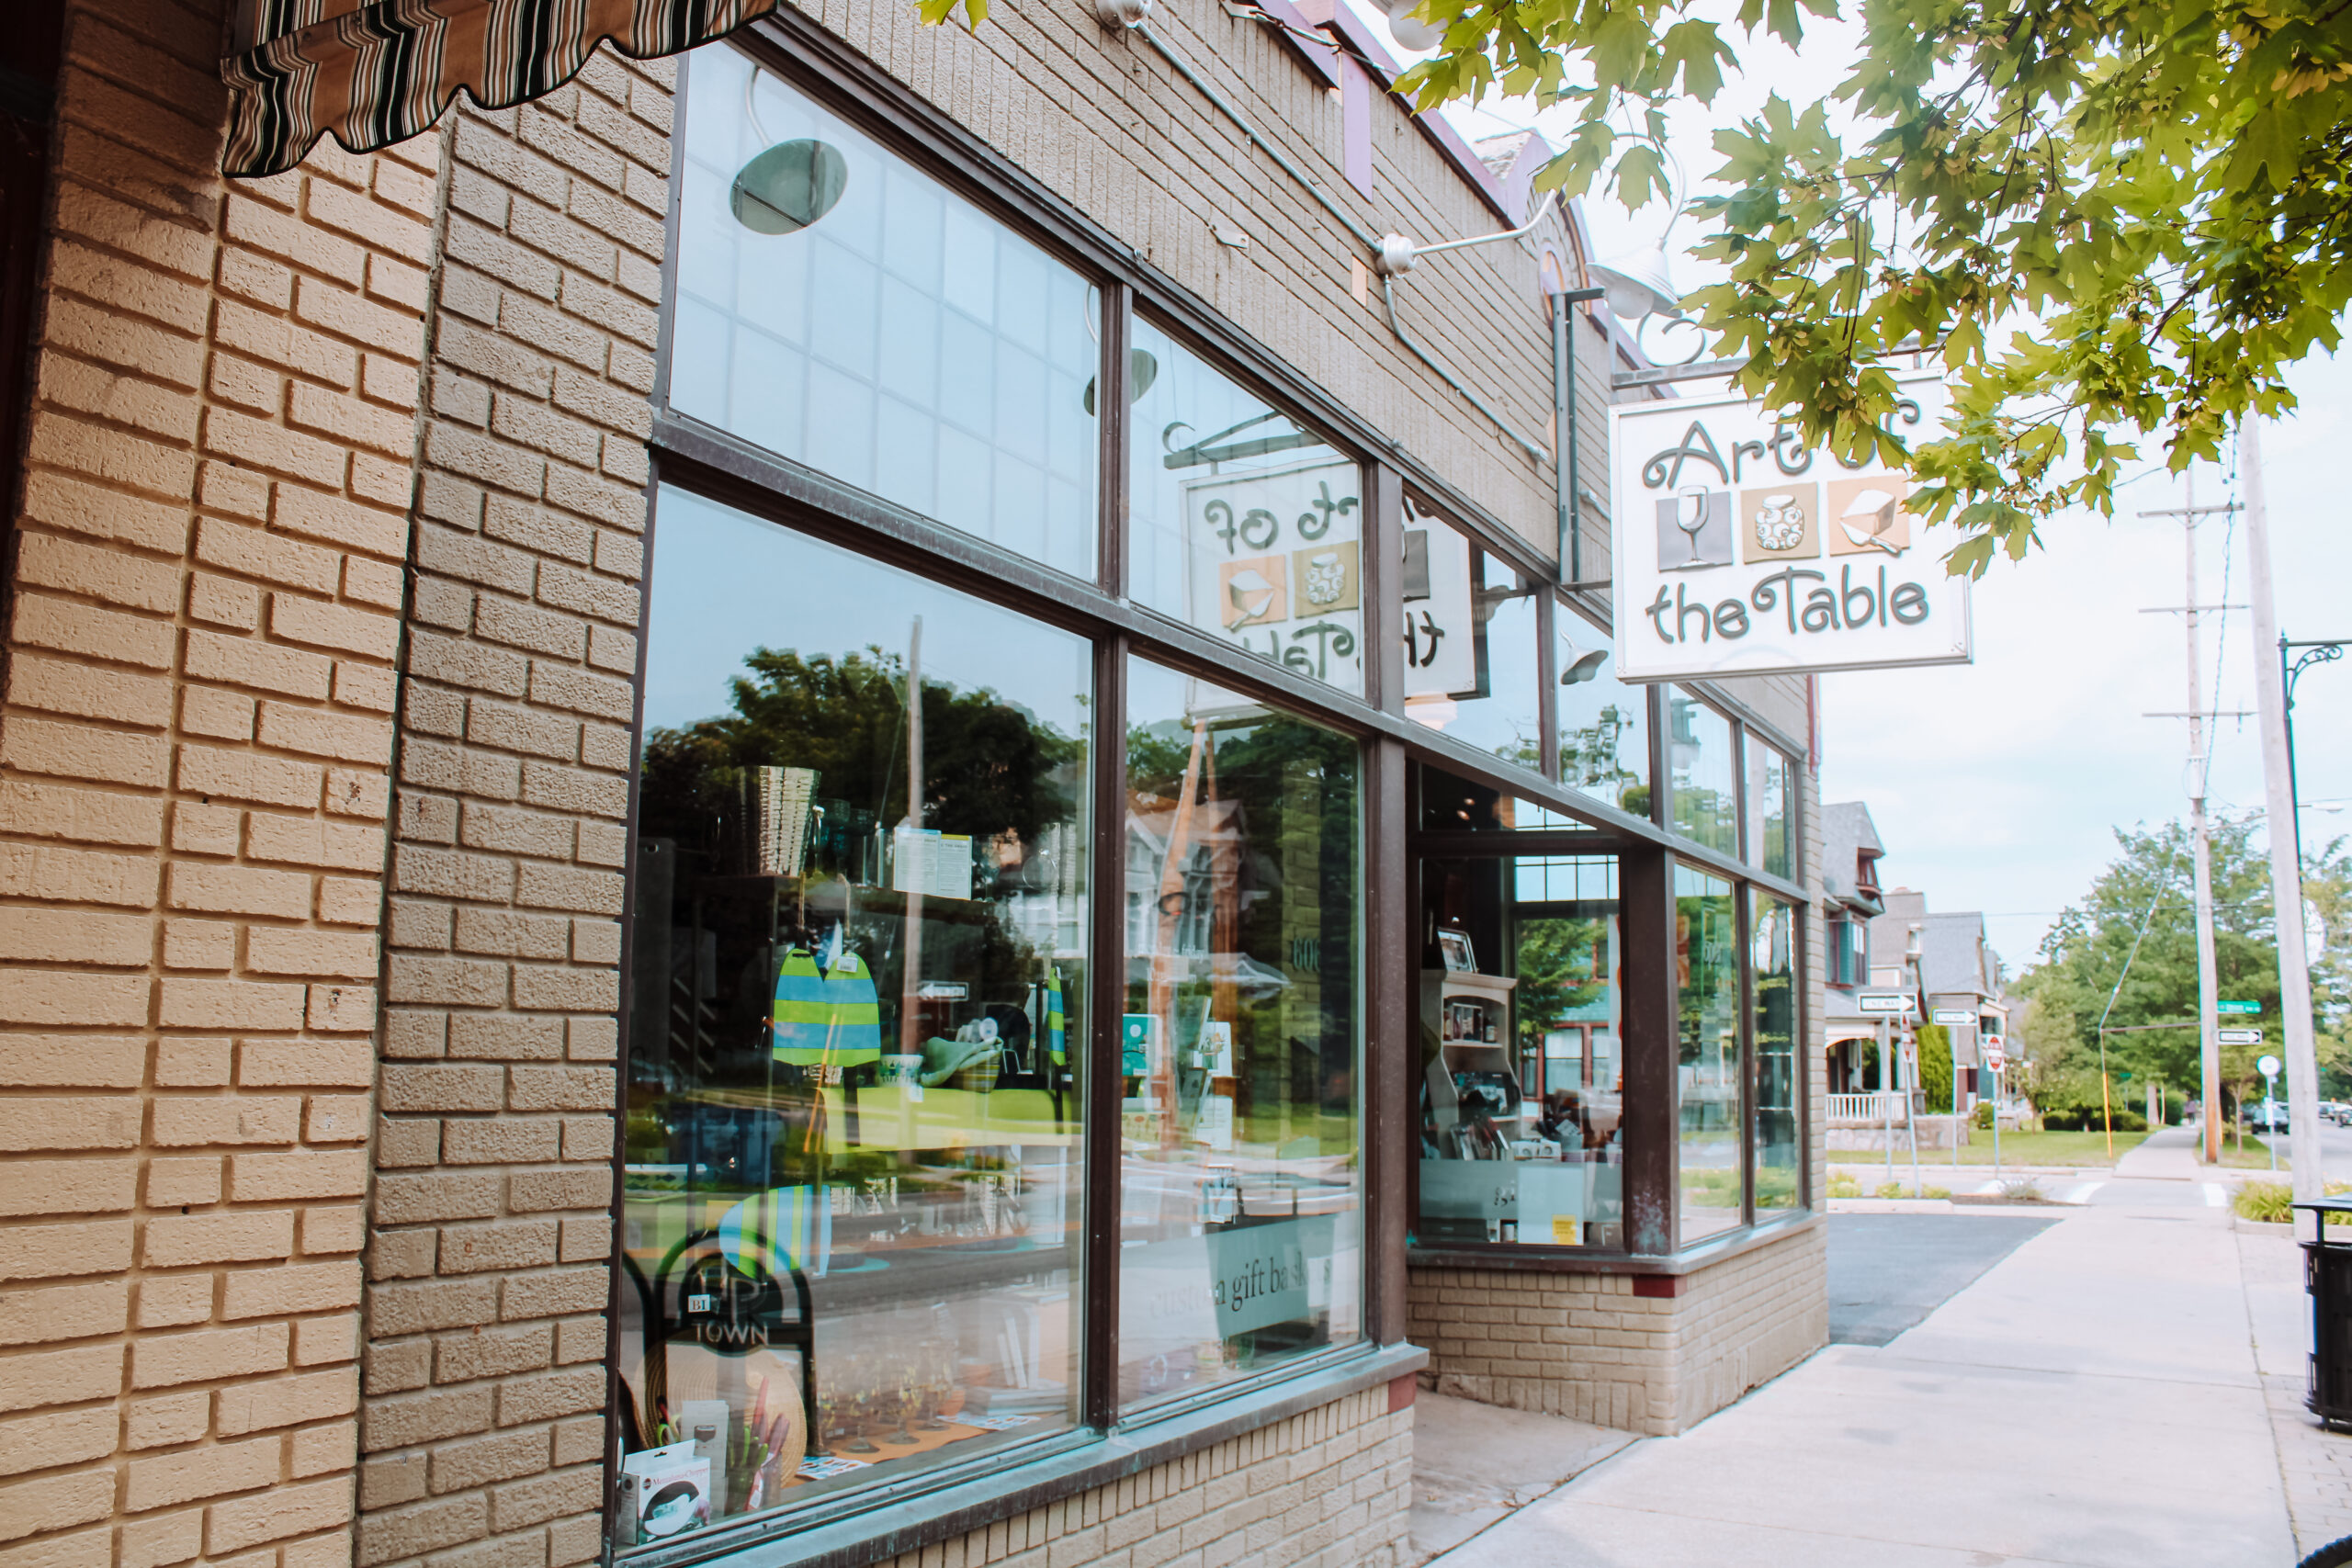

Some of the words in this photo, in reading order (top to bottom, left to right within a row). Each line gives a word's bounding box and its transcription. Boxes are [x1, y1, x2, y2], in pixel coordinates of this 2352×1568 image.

[1642, 412, 1812, 490] Art
[1645, 582, 1750, 644] the
[1751, 564, 1930, 635] Table
[1231, 1258, 1265, 1312] gift
[1270, 1250, 1331, 1293] basks
[691, 1320, 769, 1346] TOWN
